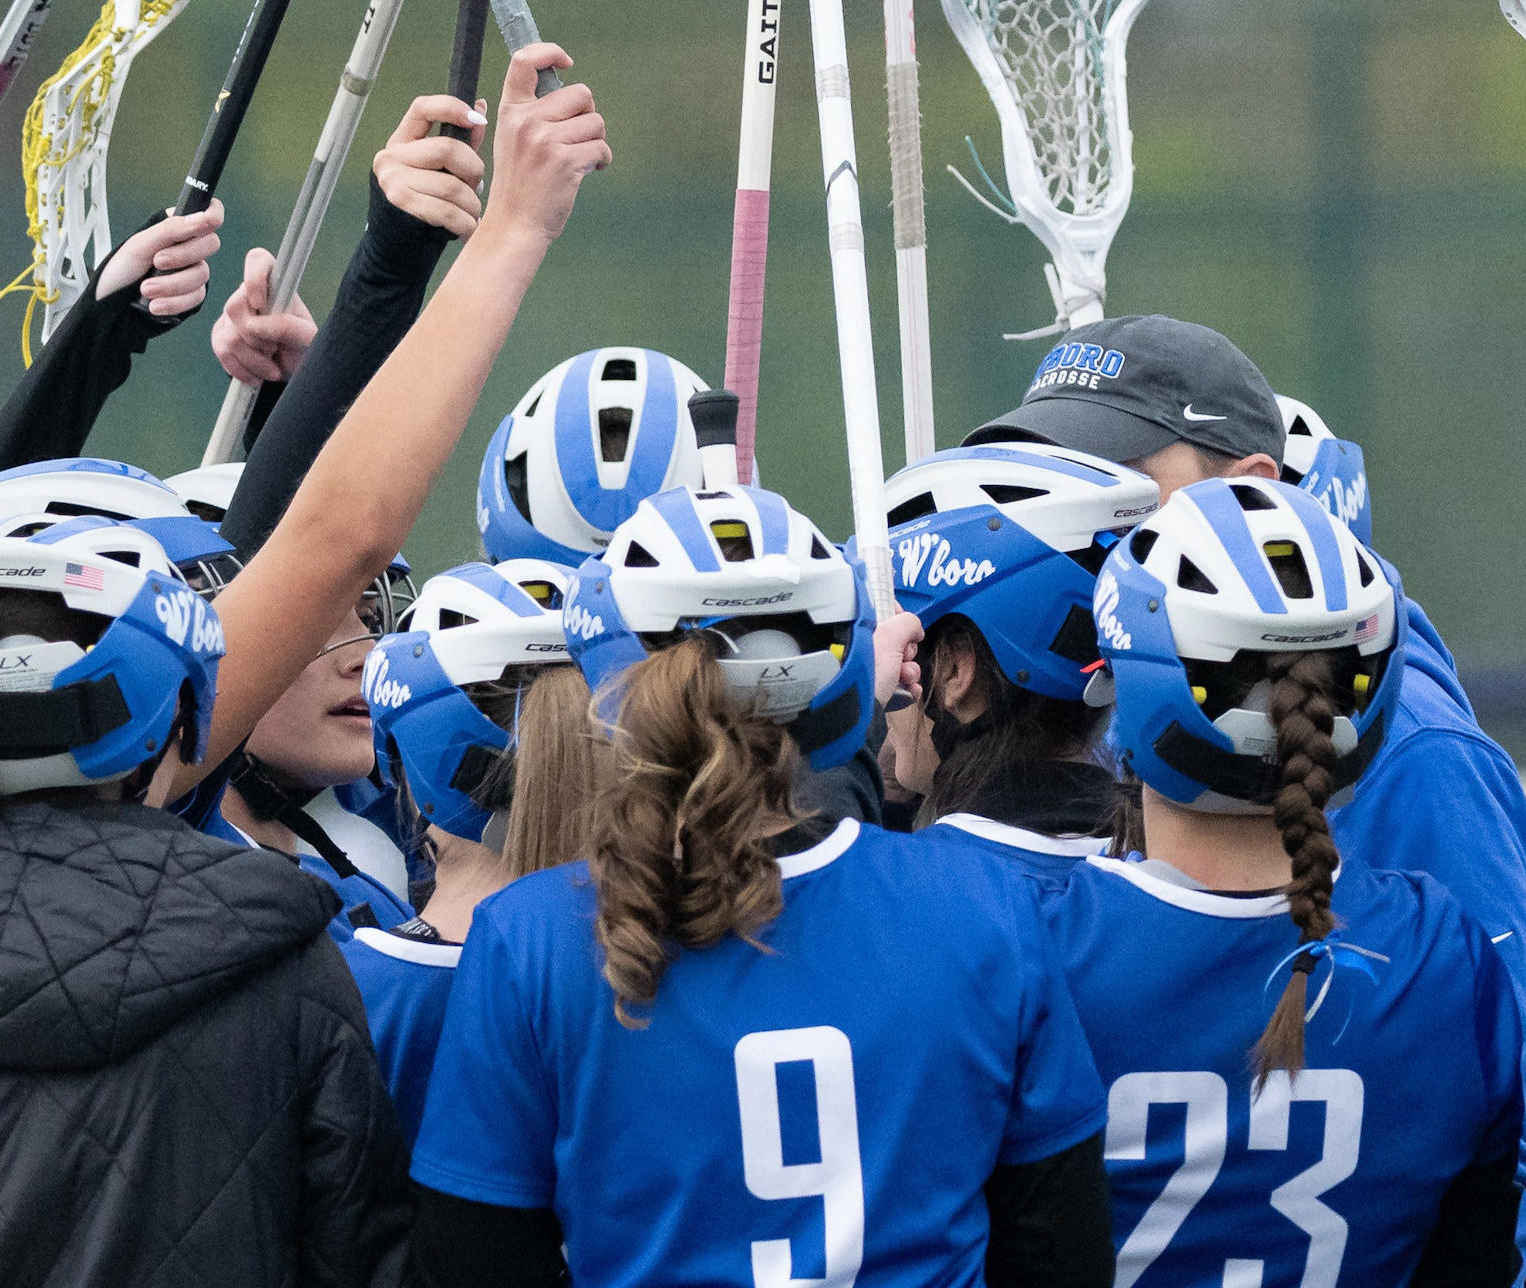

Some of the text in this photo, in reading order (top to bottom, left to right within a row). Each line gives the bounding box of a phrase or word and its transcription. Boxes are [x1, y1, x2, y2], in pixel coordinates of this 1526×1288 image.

[702, 591, 793, 608] cascade
[1260, 629, 1349, 645] cascade
[758, 663, 793, 681] LX
[733, 1024, 866, 1288] 9
[1104, 1068, 1365, 1288] 23
